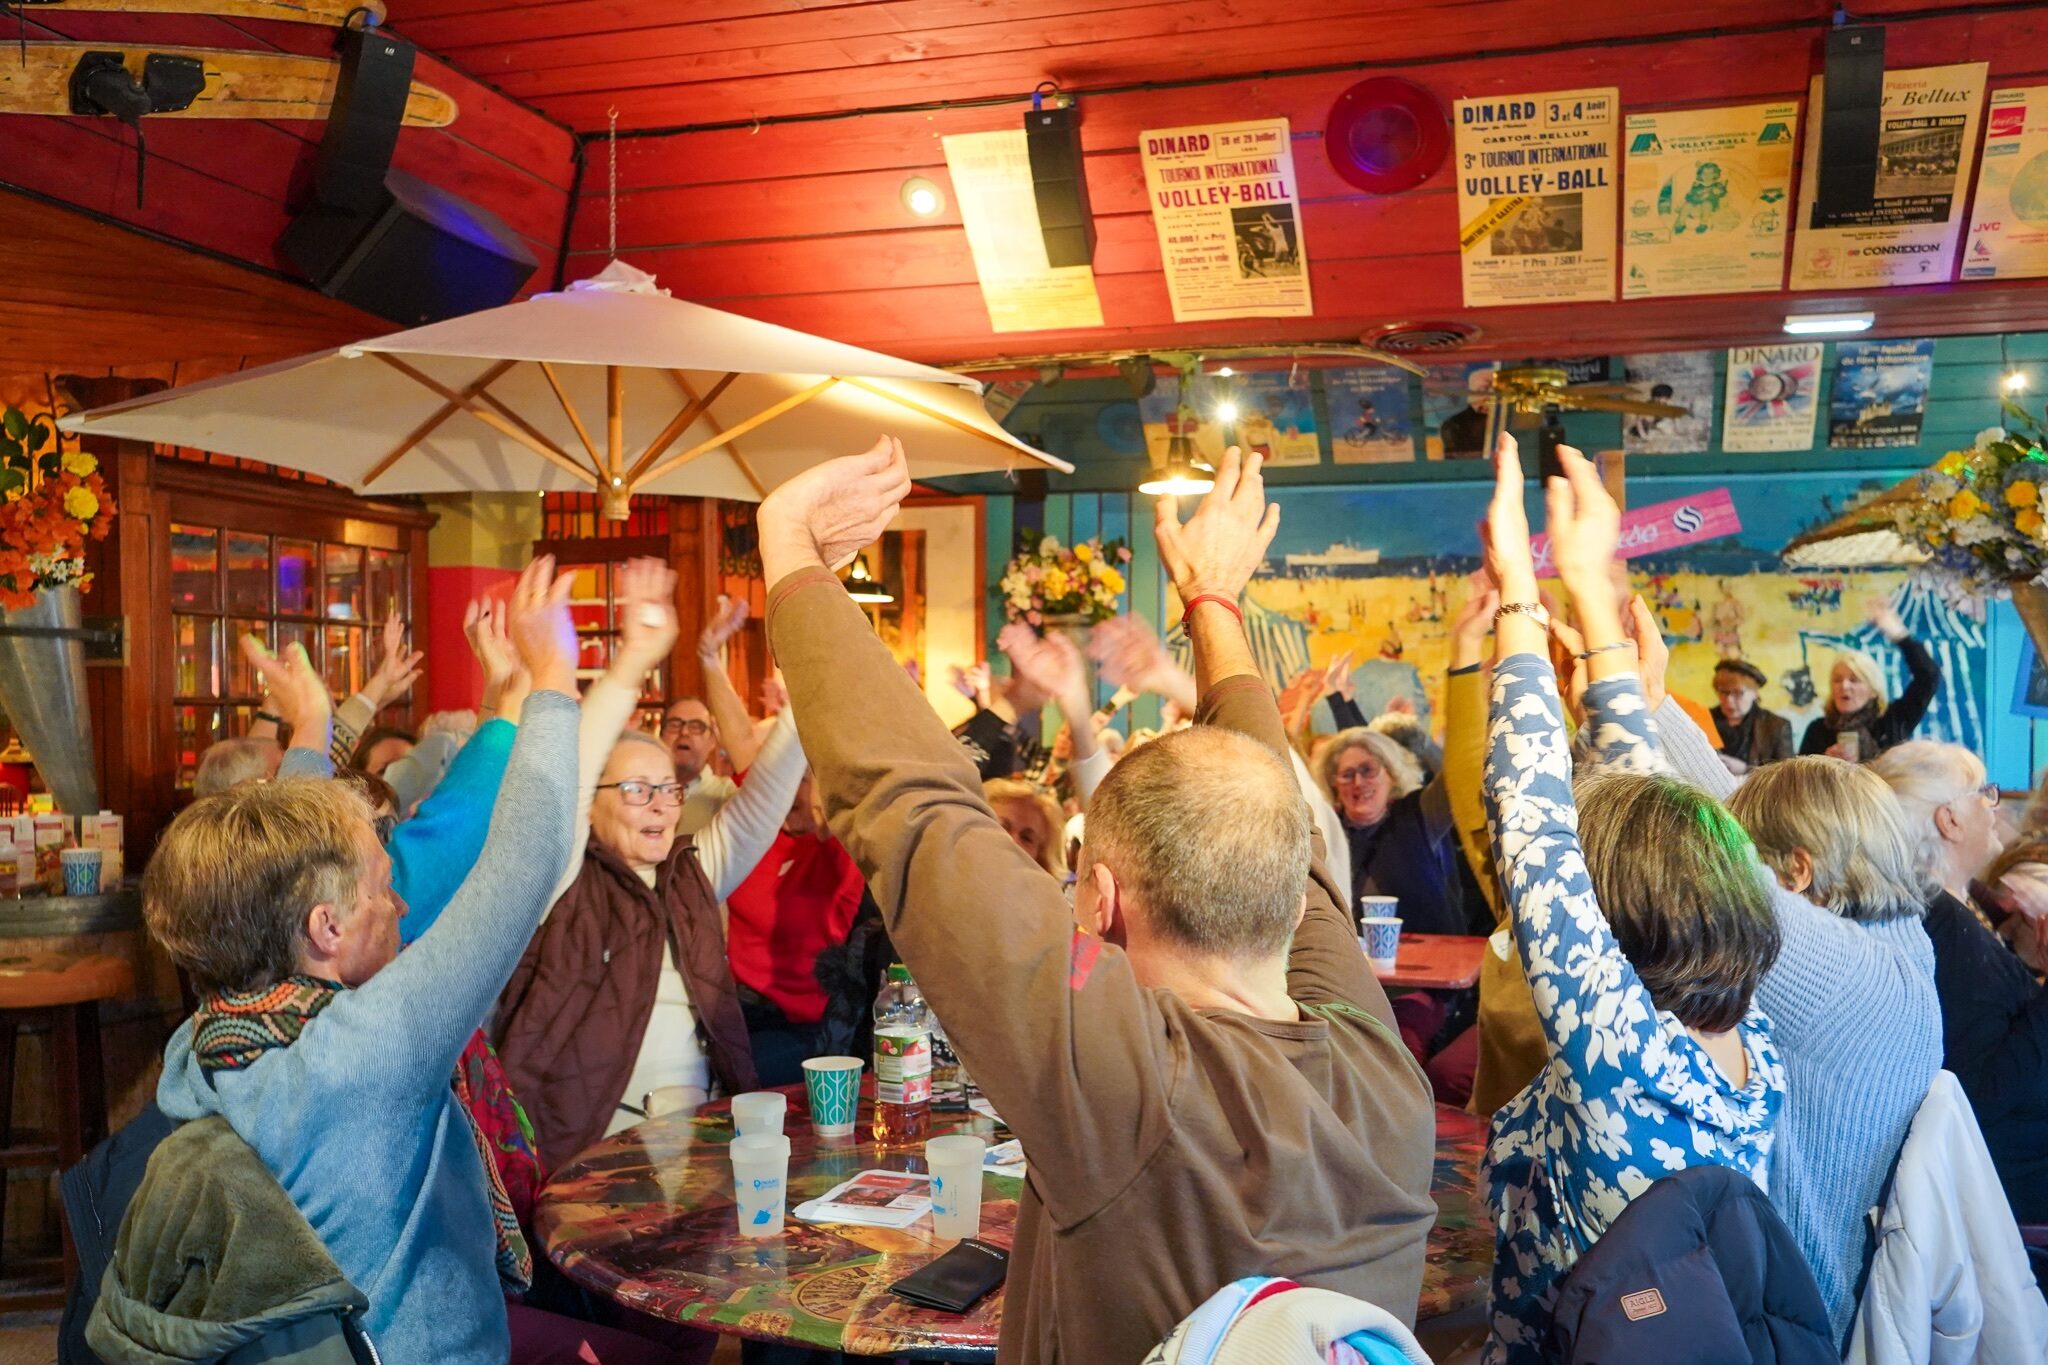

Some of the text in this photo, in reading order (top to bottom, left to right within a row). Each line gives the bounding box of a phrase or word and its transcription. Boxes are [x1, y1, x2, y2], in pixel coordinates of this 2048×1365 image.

[1902, 88, 1971, 106] Bellux
[1463, 102, 1536, 124] DINARD
[1550, 104, 1559, 122] 3
[1562, 113, 1570, 122] et
[1573, 102, 1582, 120] 4
[1147, 134, 1210, 156] DINARD
[1483, 130, 1590, 144] CASTOR-BELLUX
[1480, 149, 1525, 168] TOURNOI
[1528, 142, 1609, 165] INTERNATIONAL
[1159, 159, 1280, 184] TOURNOI INTERNATIONAL
[1466, 167, 1609, 196] VOLLEY-BALL
[1158, 181, 1290, 208] VOLLEY-BALL
[1973, 222, 2000, 232] JVC
[1863, 243, 1940, 256] CONNEXION
[1734, 347, 1820, 364] DINARD
[1630, 1295, 1655, 1307] AIGLE
